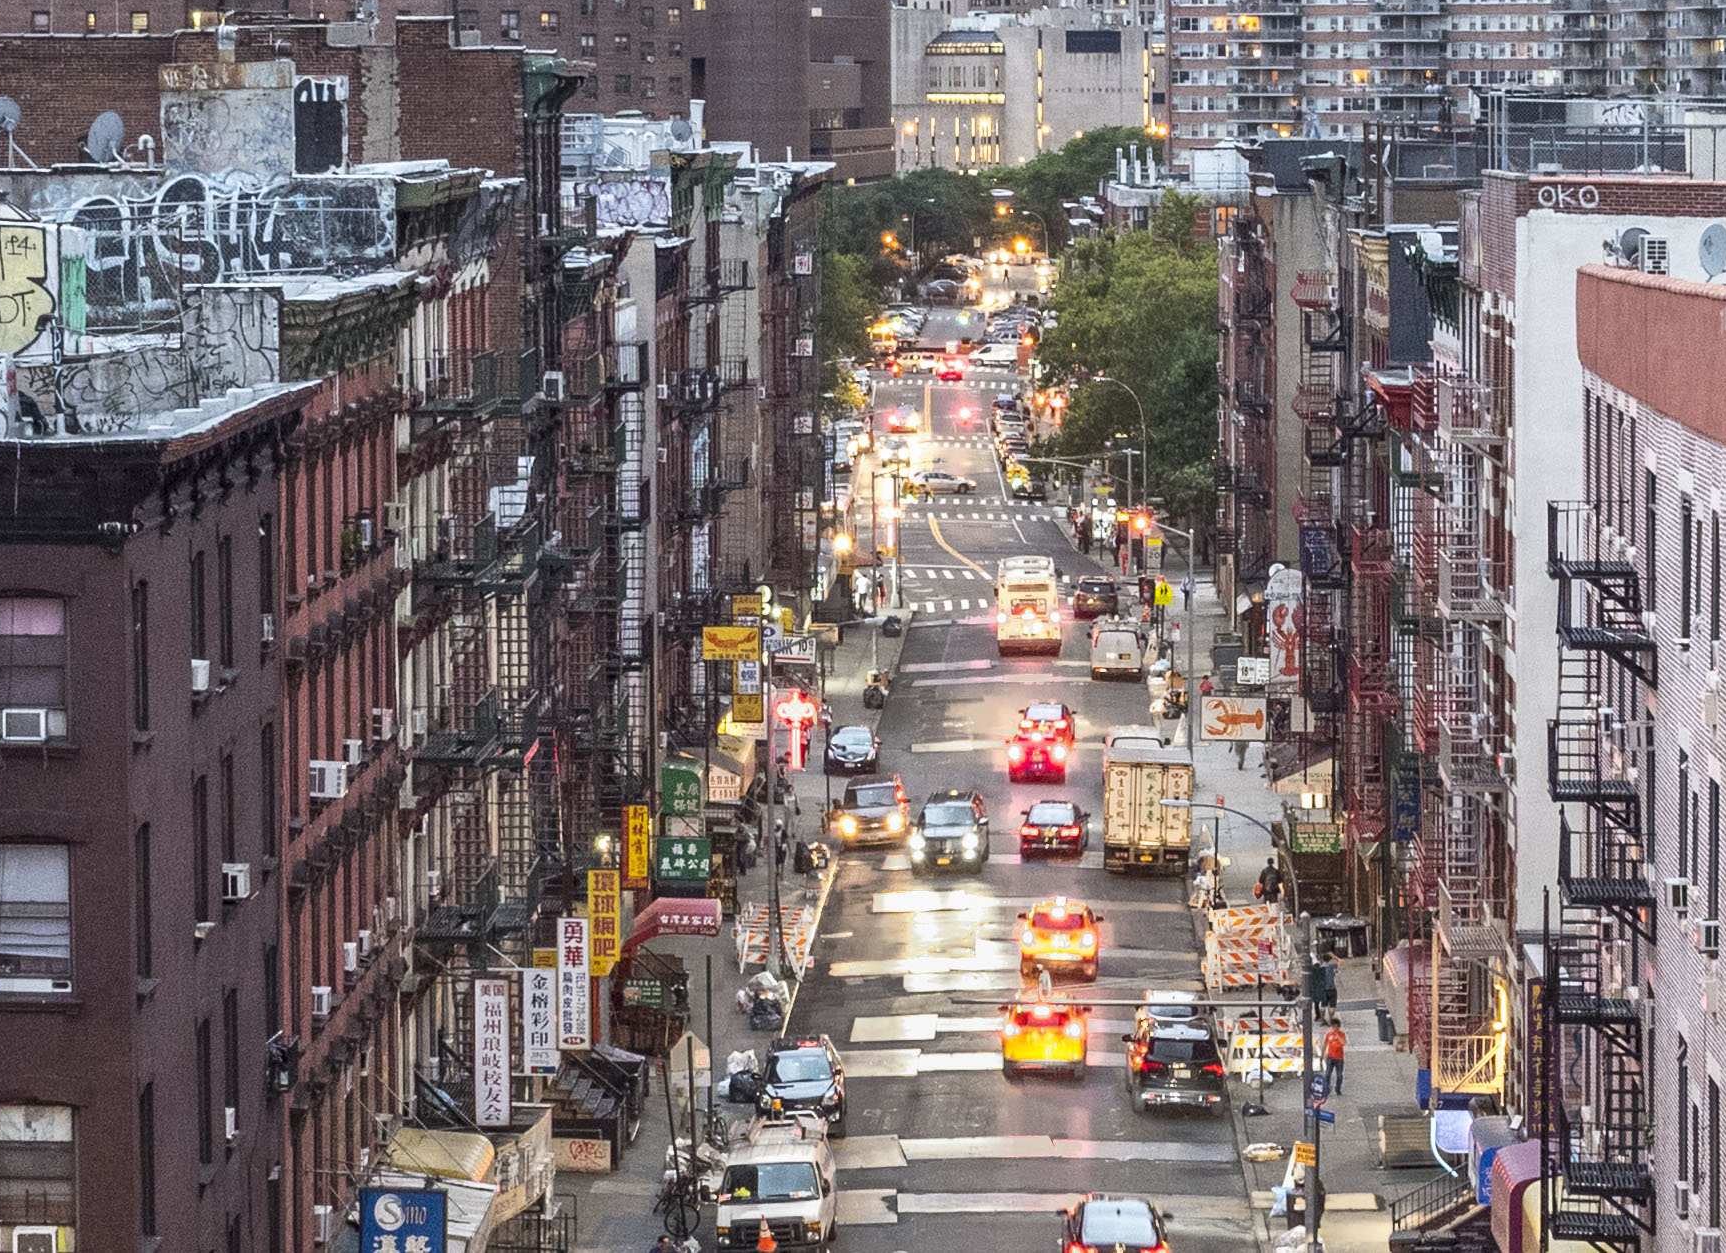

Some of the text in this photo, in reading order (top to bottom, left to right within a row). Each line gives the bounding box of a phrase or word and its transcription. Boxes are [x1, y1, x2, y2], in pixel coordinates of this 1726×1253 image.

[1538, 184, 1600, 209] OKO
[1148, 551, 1161, 559] 20
[593, 873, 616, 958] 環球網吧
[564, 921, 584, 968] 勇華
[480, 984, 505, 997] 美国
[530, 974, 550, 1047] 金榕彩印
[376, 1198, 428, 1227] Sino
